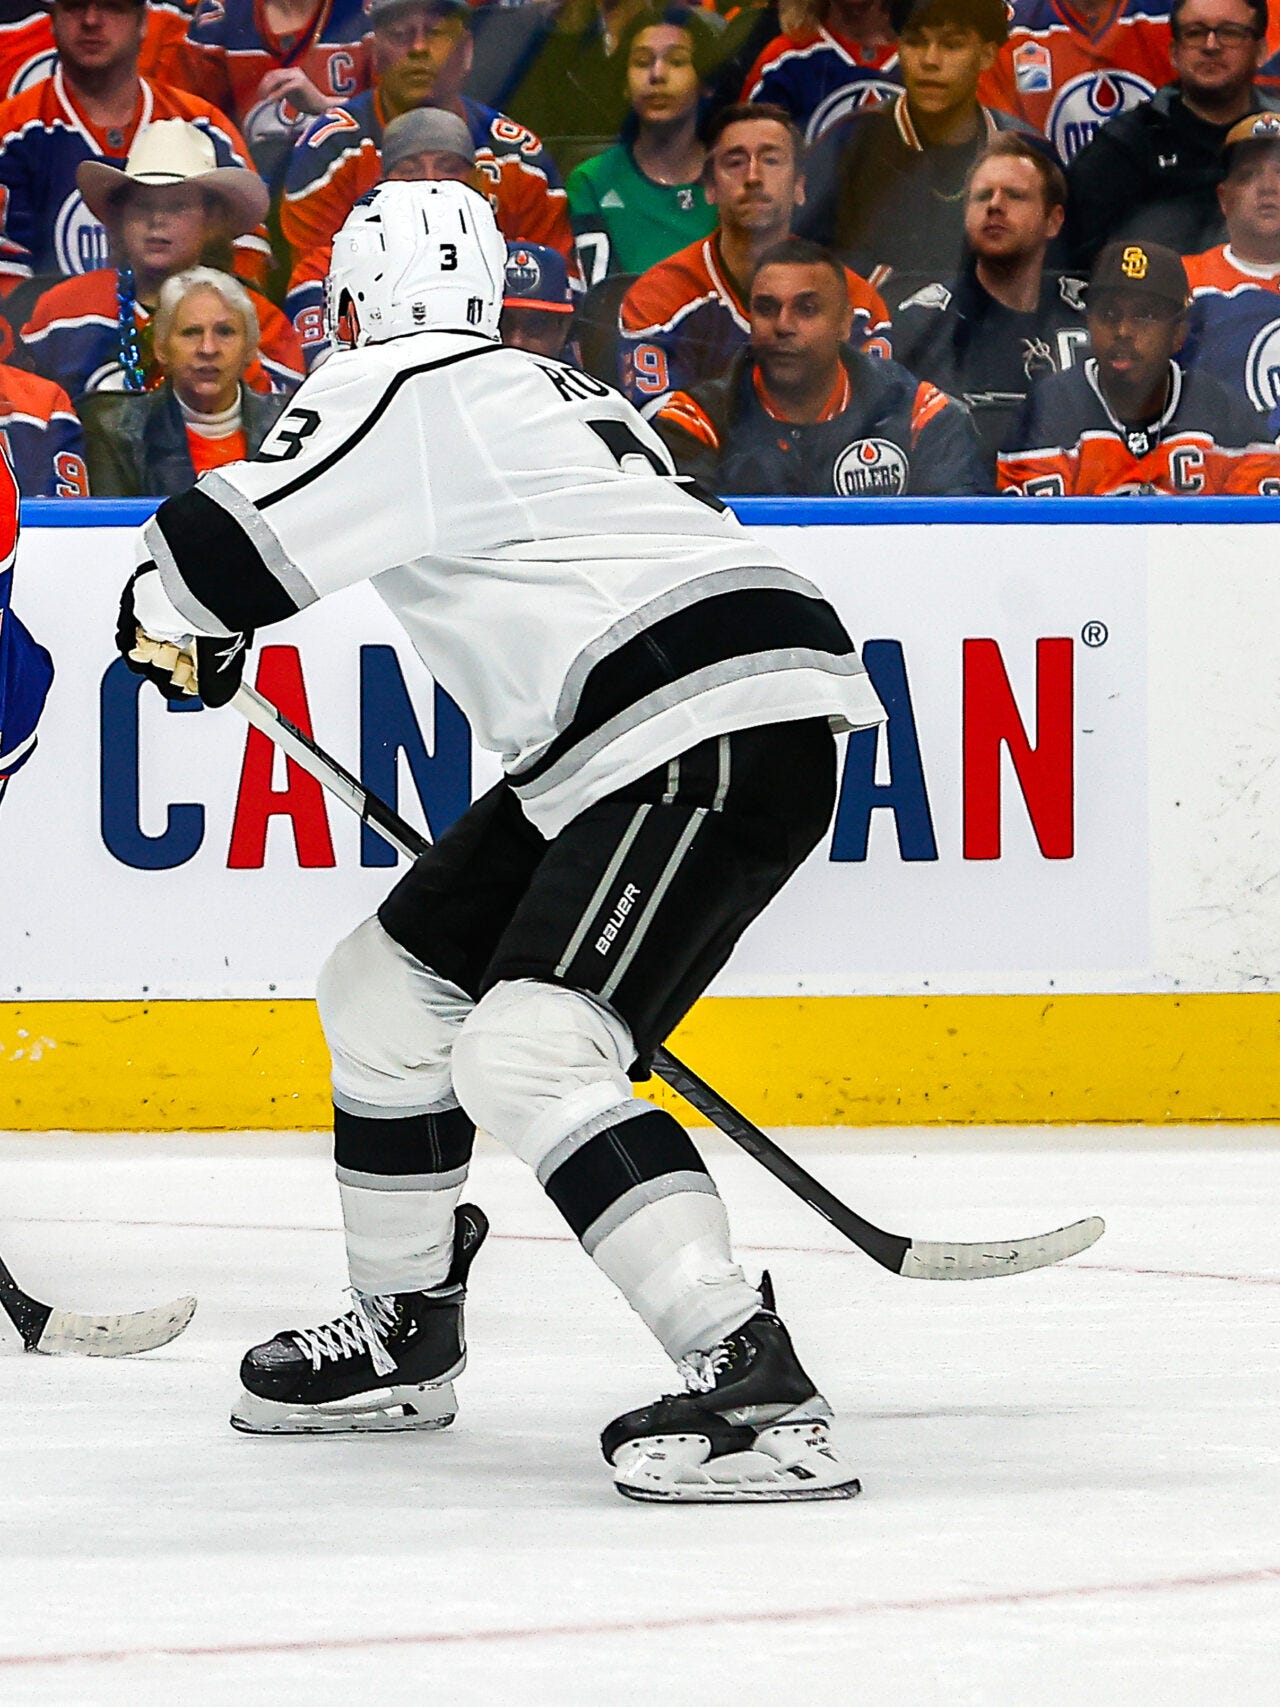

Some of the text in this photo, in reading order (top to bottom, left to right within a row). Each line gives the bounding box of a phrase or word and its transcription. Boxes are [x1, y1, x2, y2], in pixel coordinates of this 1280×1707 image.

[328, 51, 356, 95] C
[439, 243, 458, 271] 3
[255, 408, 321, 463] 3
[1169, 445, 1205, 494] C
[595, 883, 641, 956] BAUER
